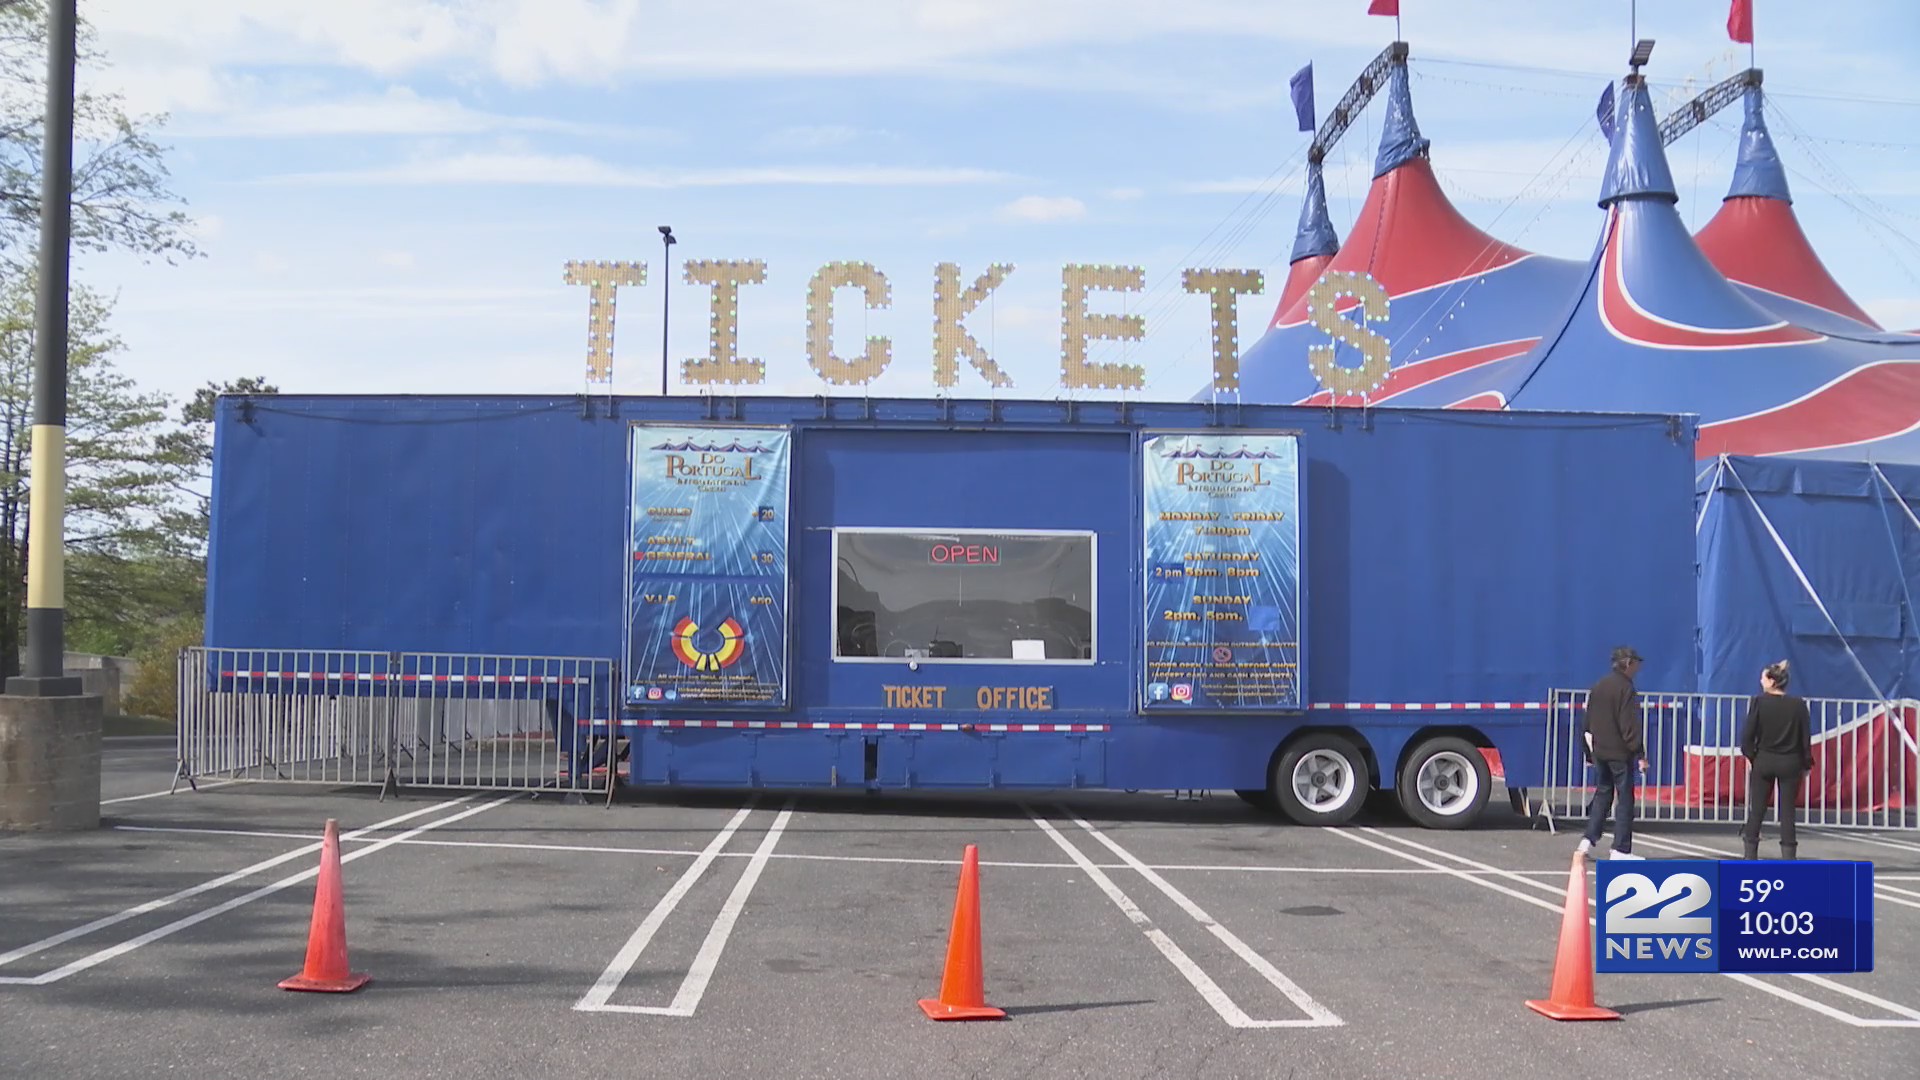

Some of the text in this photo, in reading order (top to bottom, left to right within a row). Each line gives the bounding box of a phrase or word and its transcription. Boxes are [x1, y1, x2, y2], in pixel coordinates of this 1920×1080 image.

[563, 259, 1391, 397] TICKETS
[762, 510, 774, 519] 20
[1159, 512, 1220, 521] MONDAY
[1233, 512, 1285, 521] FRIDAY
[646, 552, 773, 563] GENERAL 30
[931, 544, 998, 563] OPEN
[1184, 552, 1259, 561] SATURDAY
[1165, 569, 1182, 579] pm
[1227, 567, 1259, 577] 8pm
[1193, 595, 1251, 604] SUNDAY
[1206, 611, 1243, 621] 5pm,
[883, 685, 1053, 710] TICKET OFFICE
